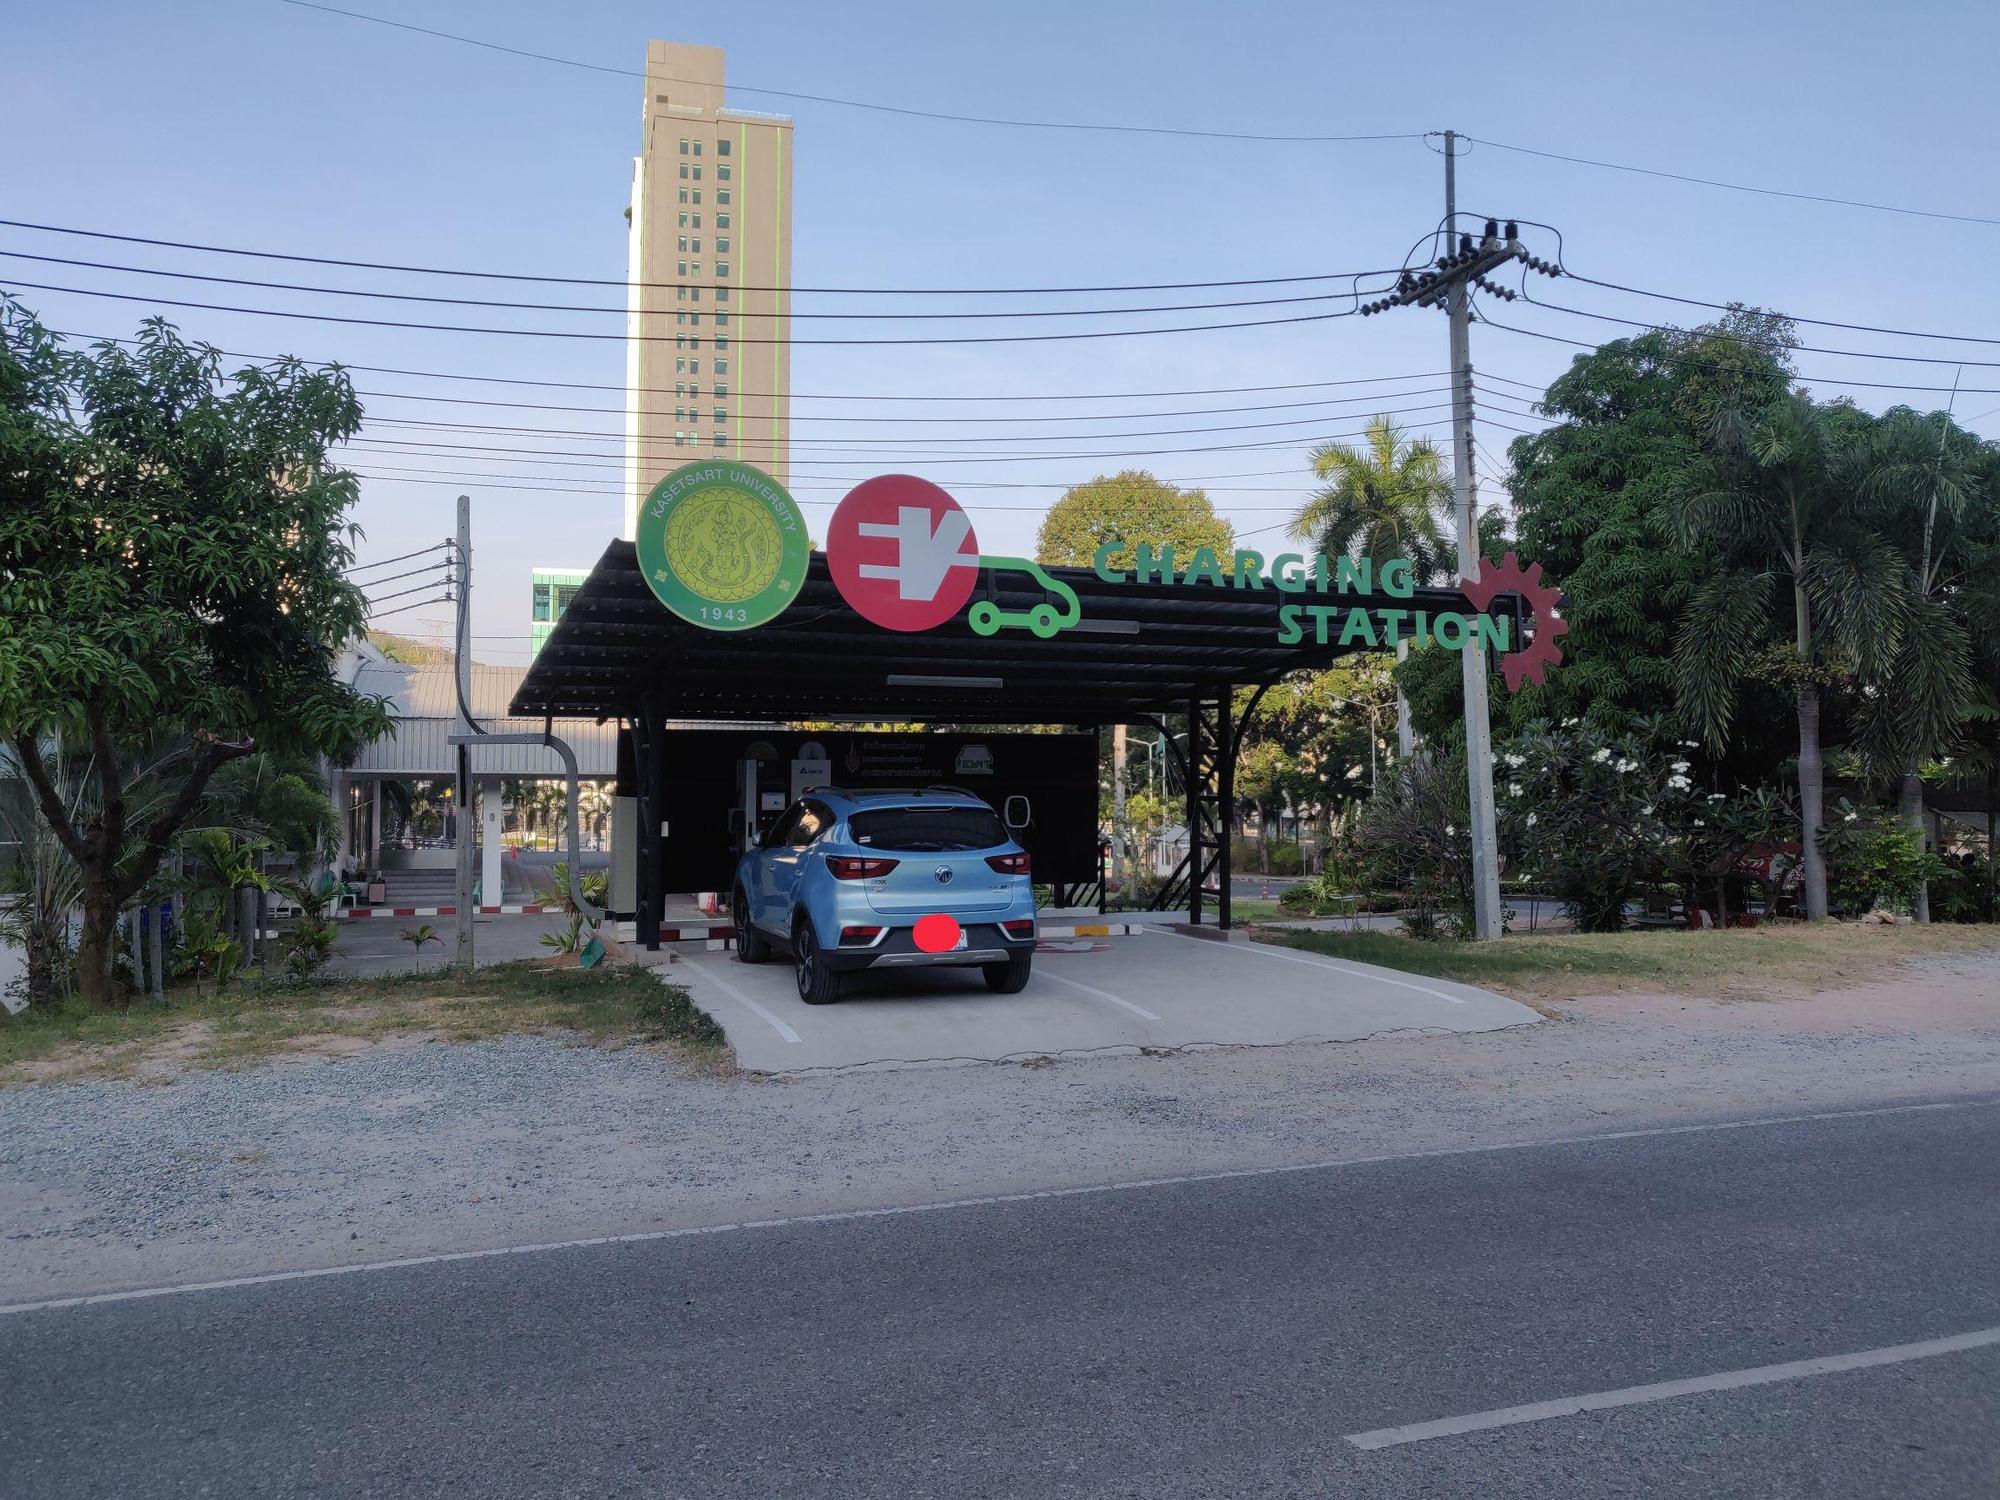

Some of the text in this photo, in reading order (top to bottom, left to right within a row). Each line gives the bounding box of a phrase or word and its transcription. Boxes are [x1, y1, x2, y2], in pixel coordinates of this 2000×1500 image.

[651, 468, 797, 532] KASETSART UNIVERSITY
[1094, 542, 1414, 598] CHARGING
[700, 606, 747, 622] 1943
[1278, 604, 1509, 651] STATION
